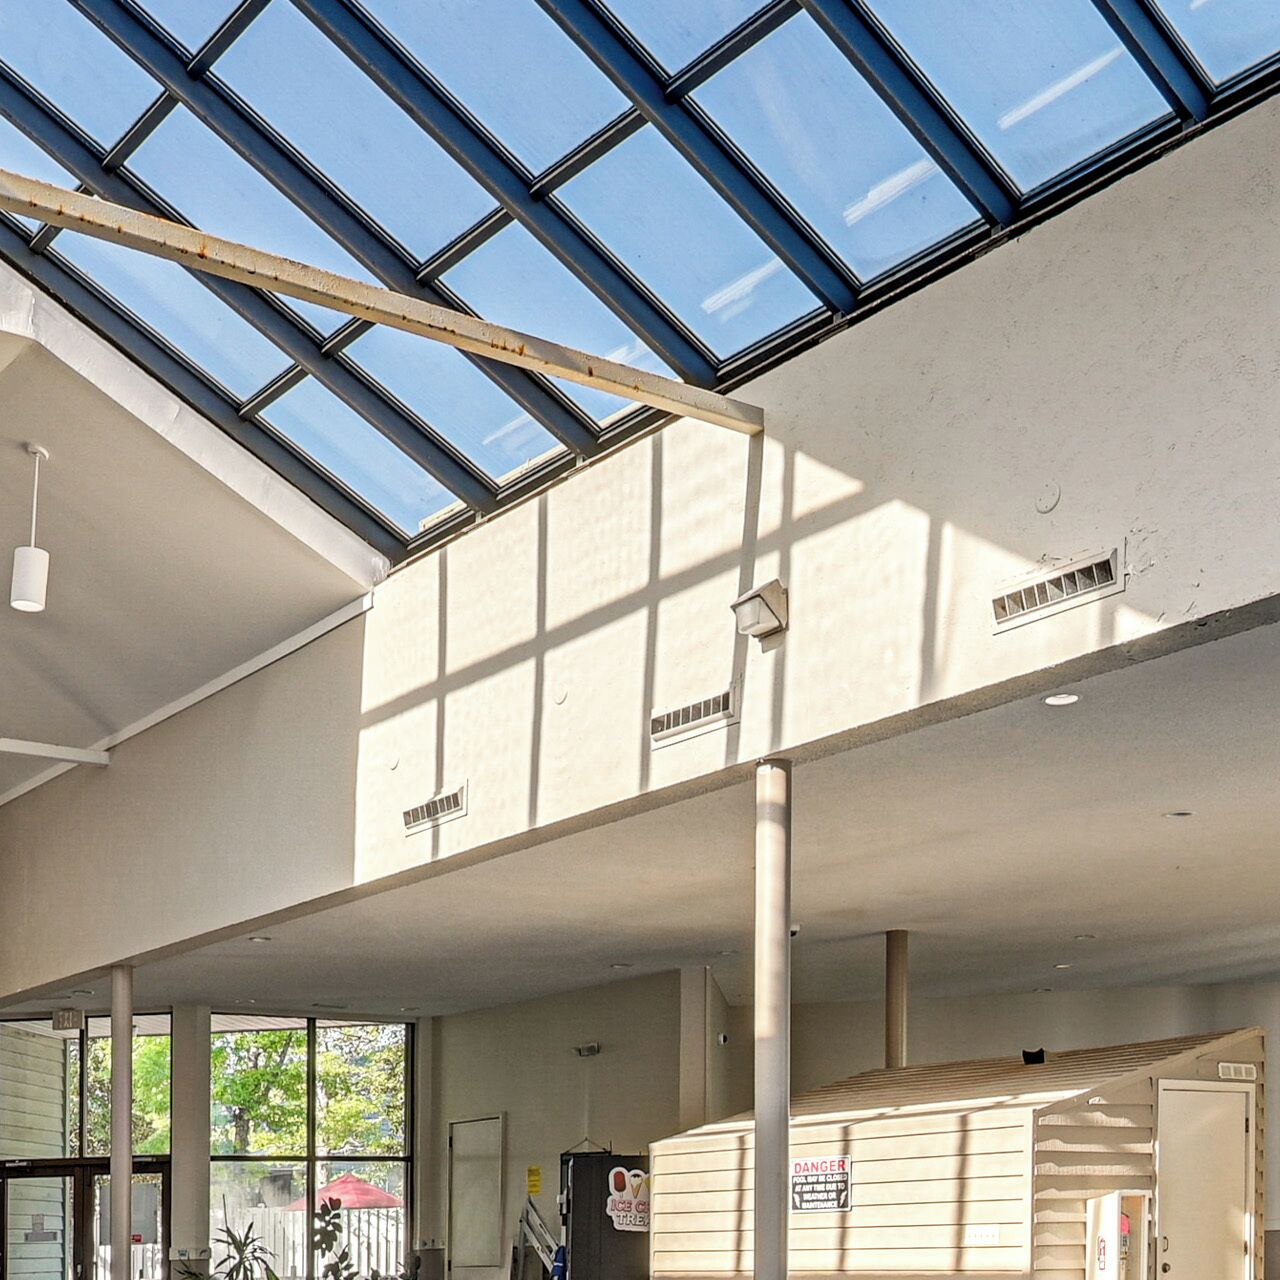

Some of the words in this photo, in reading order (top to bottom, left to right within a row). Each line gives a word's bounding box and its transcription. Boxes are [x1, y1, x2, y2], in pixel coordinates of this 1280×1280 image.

[794, 1160, 846, 1174] DANGER
[838, 1182, 846, 1190] TO
[610, 1200, 632, 1212] ICE
